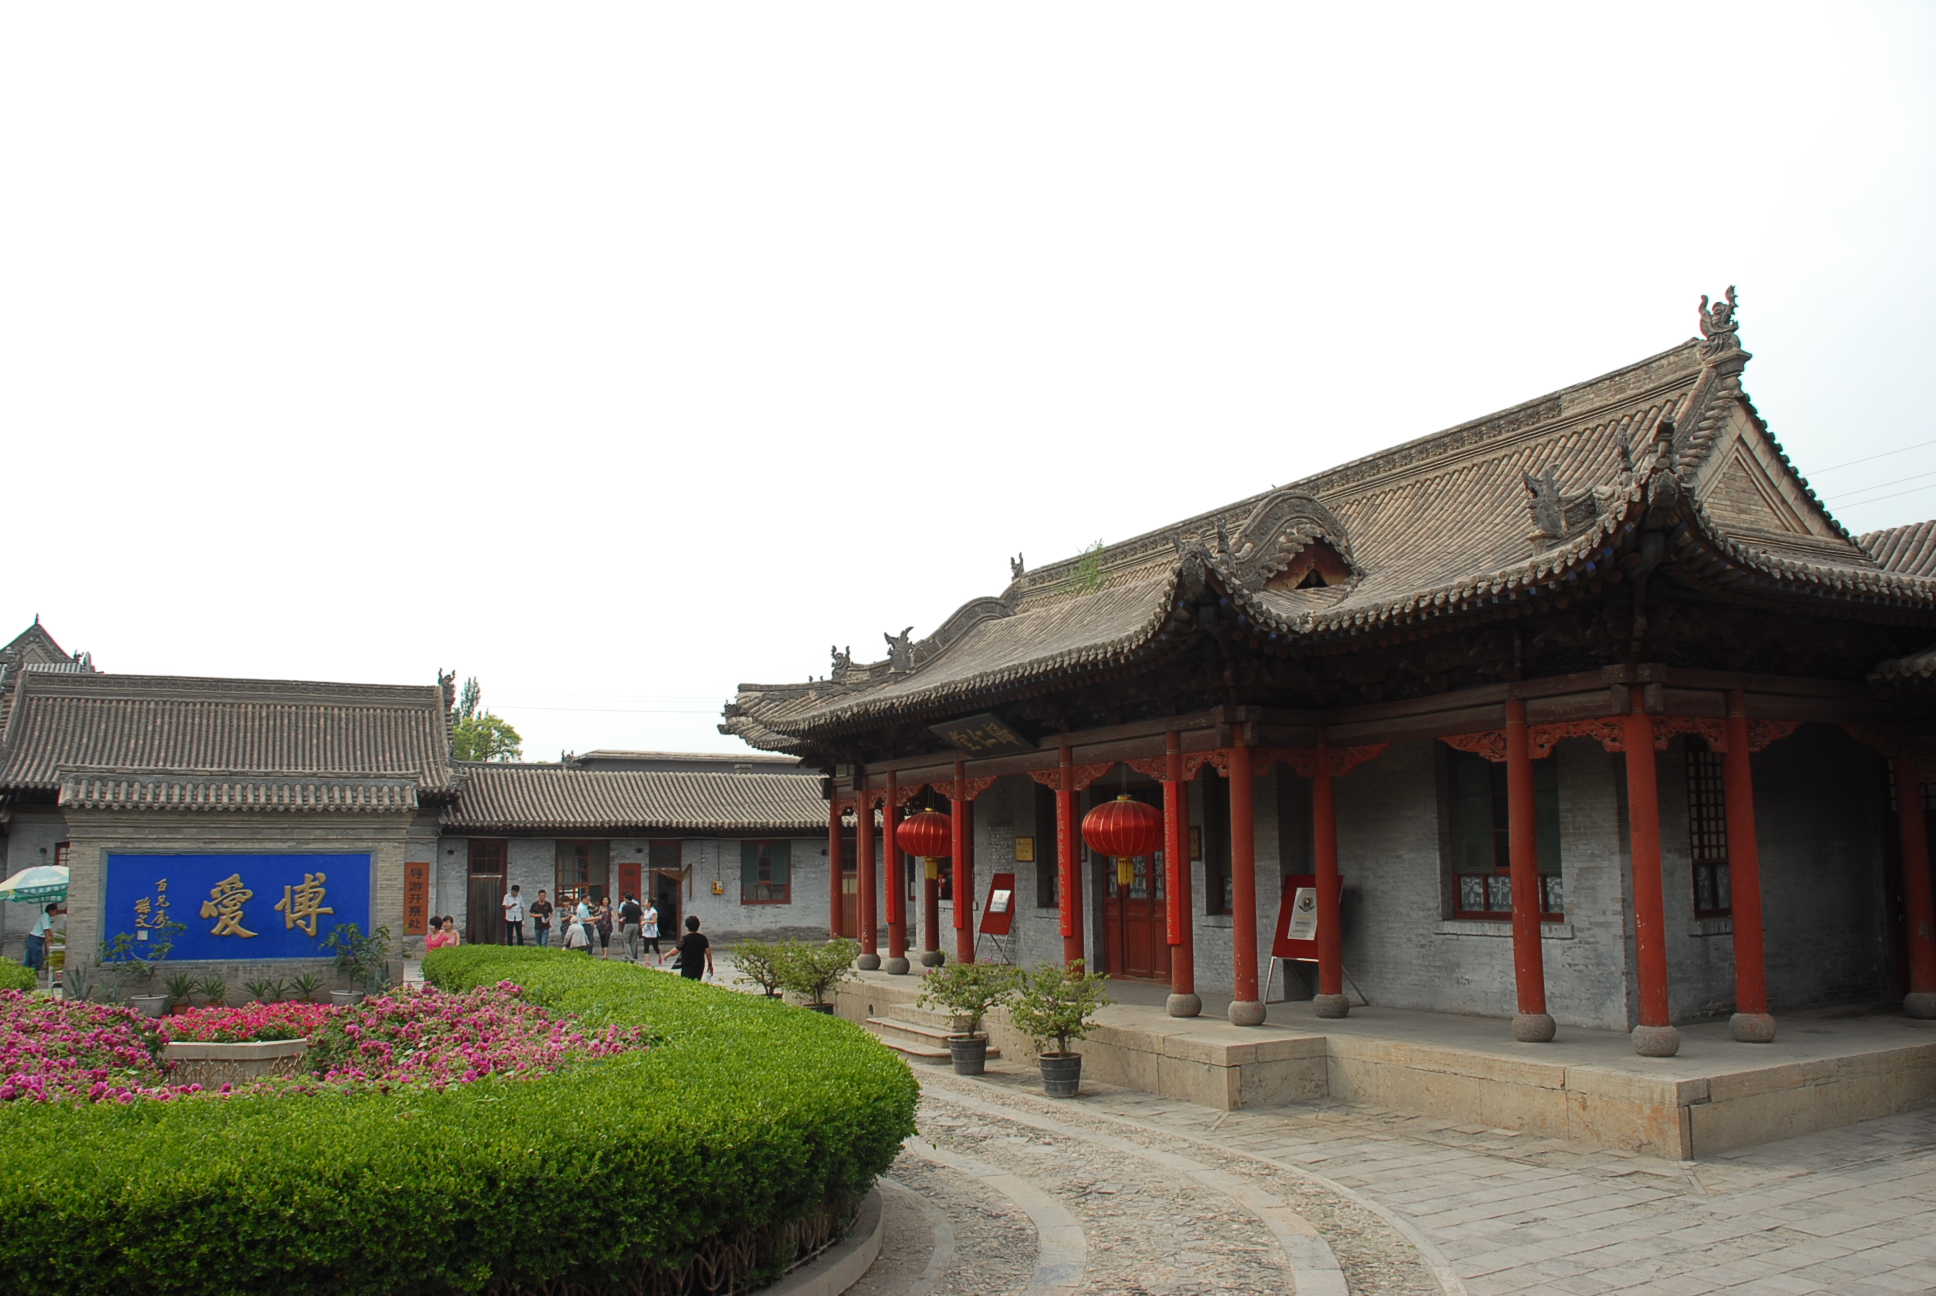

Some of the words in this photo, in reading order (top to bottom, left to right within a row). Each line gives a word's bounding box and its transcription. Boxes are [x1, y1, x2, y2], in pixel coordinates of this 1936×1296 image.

[408, 868, 423, 930] 导游开票处
